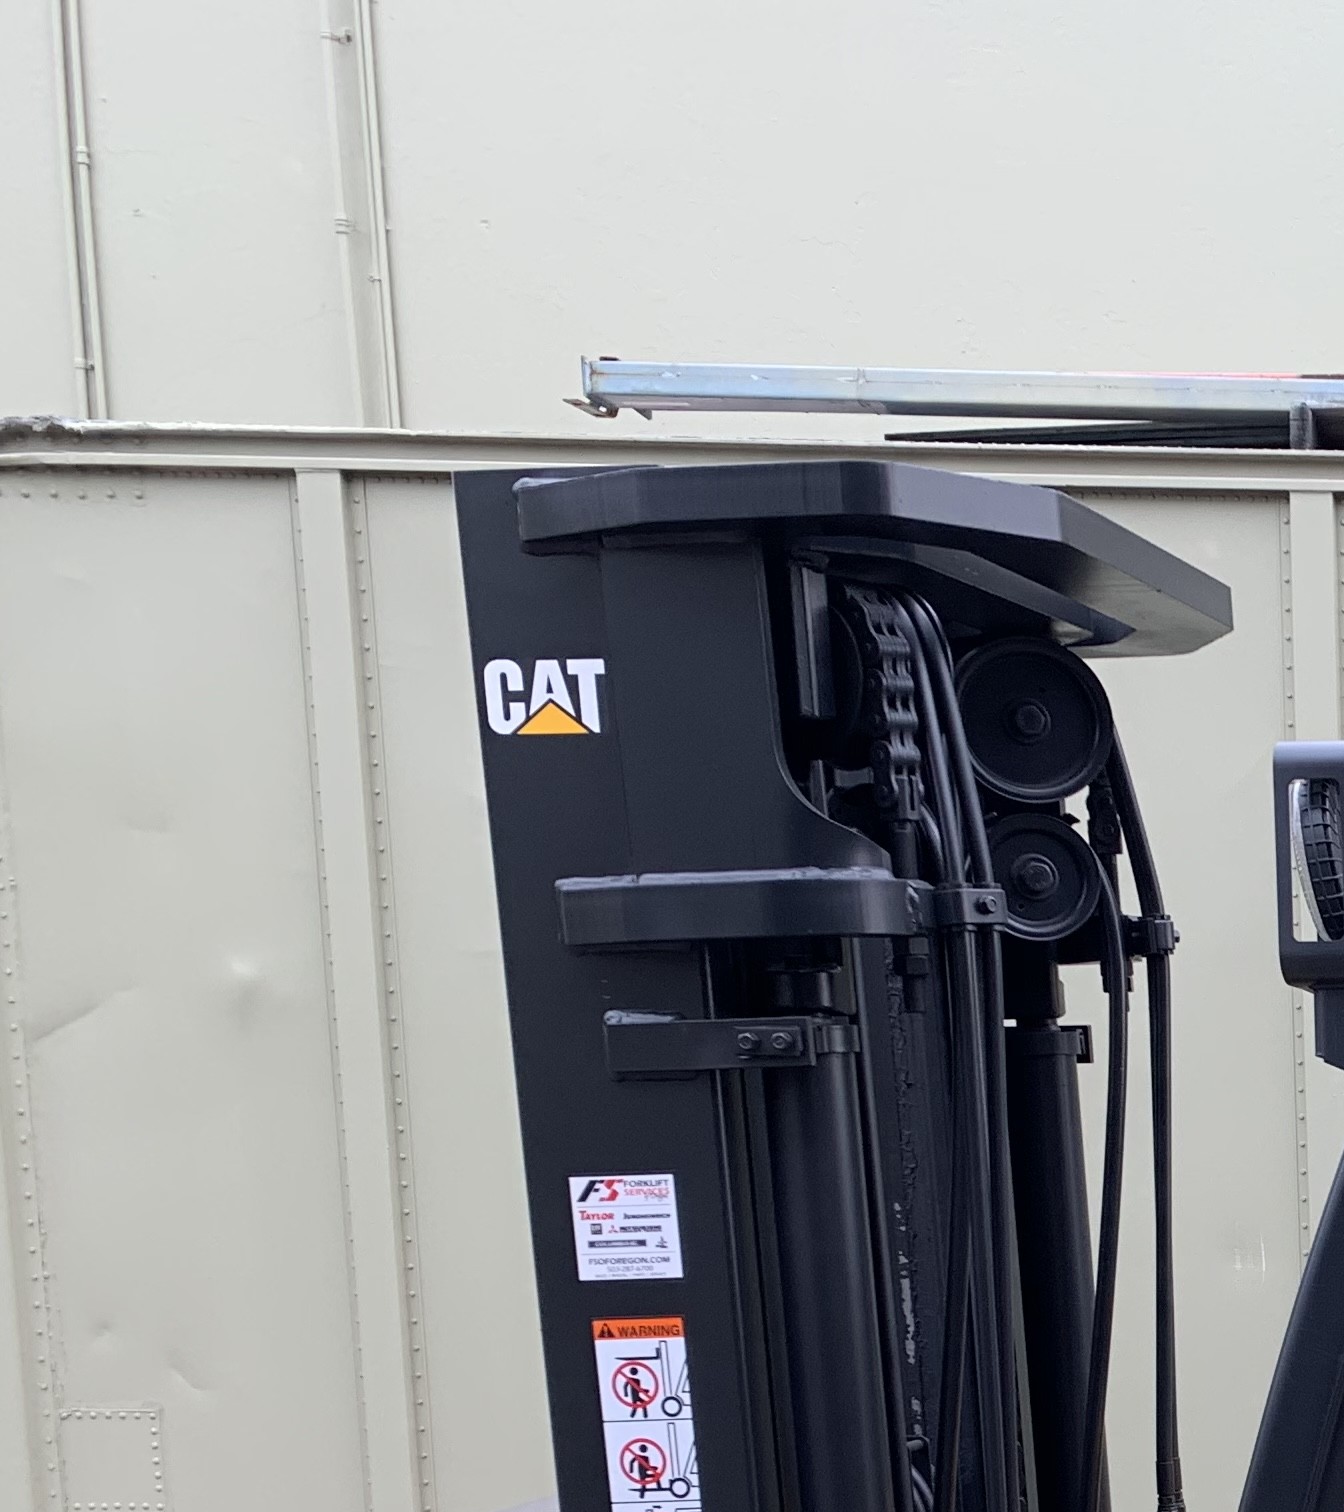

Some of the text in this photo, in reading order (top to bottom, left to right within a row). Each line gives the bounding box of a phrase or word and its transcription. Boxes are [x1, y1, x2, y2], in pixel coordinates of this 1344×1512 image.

[484, 658, 605, 735] CAT
[624, 1187, 670, 1196] SERVICES
[617, 1324, 681, 1338] WARNING
